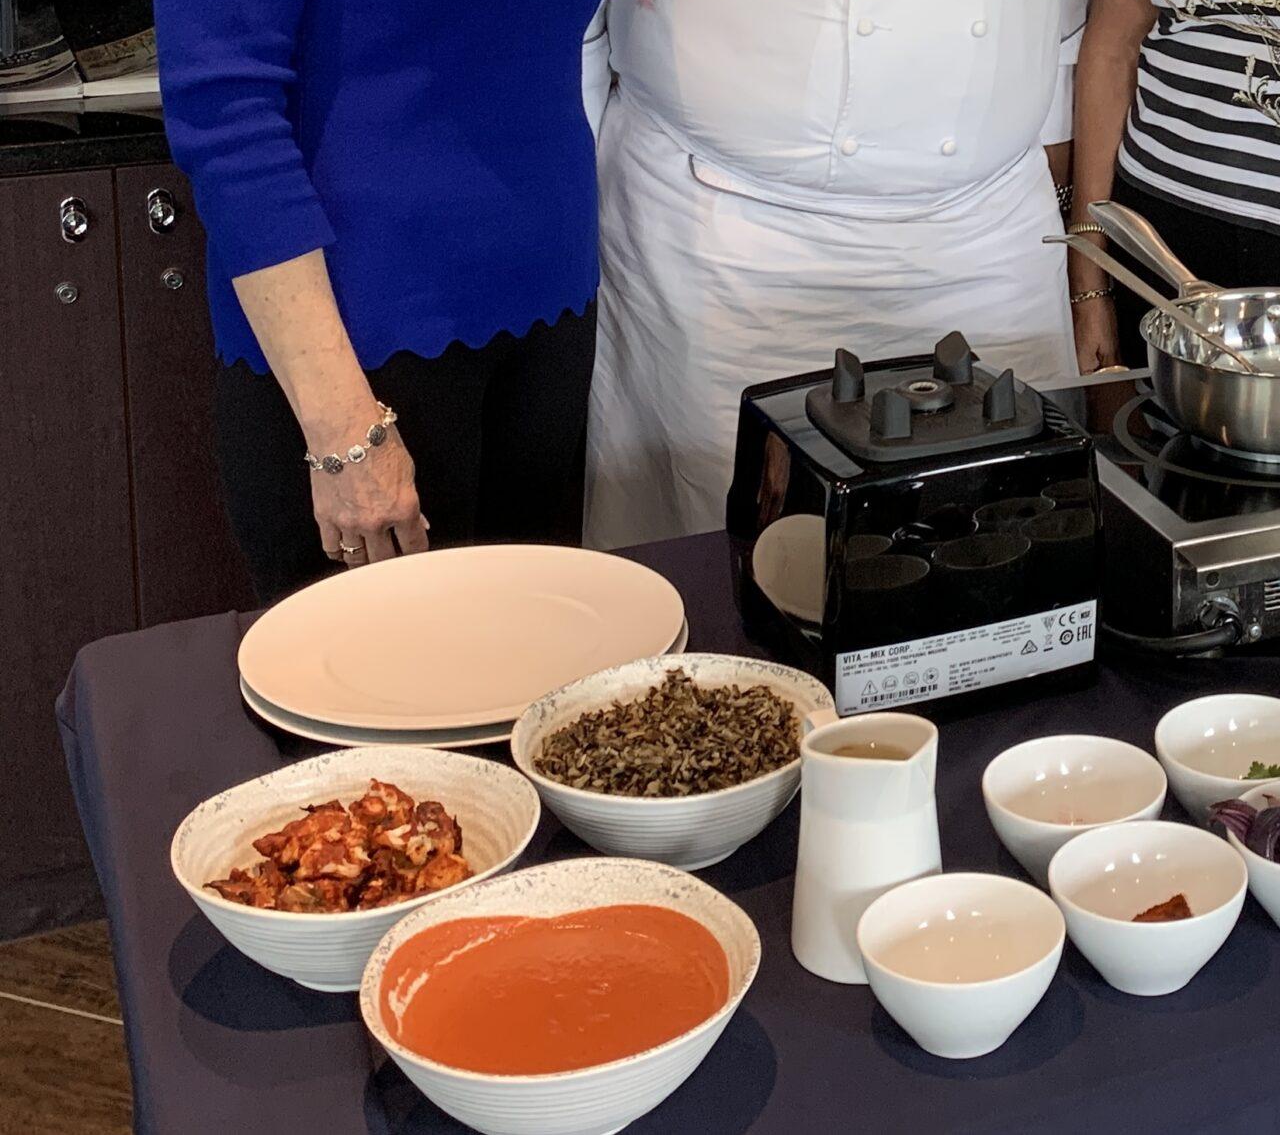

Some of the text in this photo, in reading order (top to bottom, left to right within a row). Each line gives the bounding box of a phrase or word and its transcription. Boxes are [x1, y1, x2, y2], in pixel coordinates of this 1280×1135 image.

[1059, 611, 1076, 626] CE
[843, 652, 861, 664] VITA
[871, 649, 885, 659] MIX
[888, 645, 912, 656] CORP.
